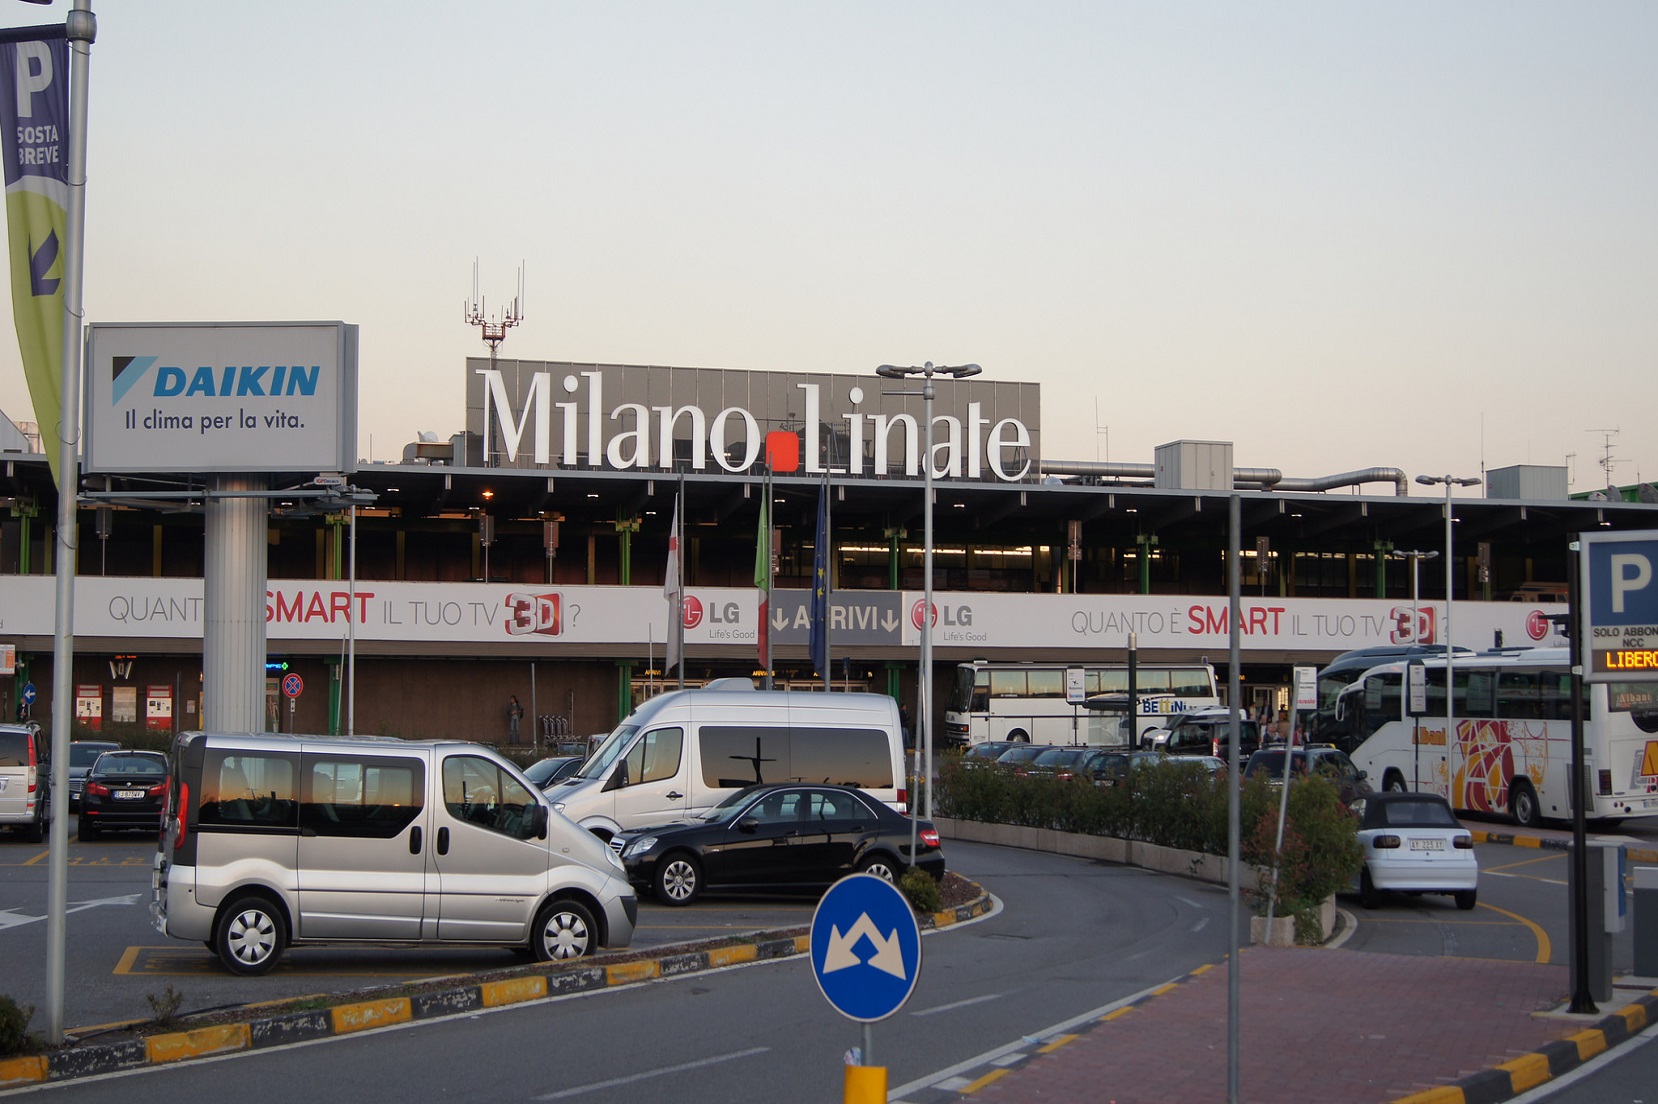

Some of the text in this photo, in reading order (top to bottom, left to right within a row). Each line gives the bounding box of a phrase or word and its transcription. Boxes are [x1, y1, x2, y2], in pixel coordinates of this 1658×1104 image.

[16, 40, 53, 117] P
[17, 125, 58, 144] SOSTA
[19, 145, 59, 165] BREVE
[153, 366, 320, 396] DAIKIN
[125, 408, 305, 434] Il clima per la vita.
[475, 369, 1031, 481] Milano Linate
[1611, 554, 1652, 613] P
[109, 596, 205, 624] QUANT
[384, 601, 403, 624] IL
[409, 601, 462, 625] TUO
[468, 602, 499, 626] TV
[504, 592, 560, 637] 3D
[709, 602, 740, 624] LG
[793, 605, 878, 631] ARIVI
[944, 605, 972, 626] LG
[1071, 611, 1164, 636] QUANTO
[1292, 614, 1308, 636] IL
[1312, 614, 1356, 637] TUO
[1360, 616, 1385, 637] TV
[709, 629, 755, 639] Life's Good
[944, 631, 987, 641] Life's Good
[1593, 627, 1620, 637] SOLO
[1622, 637, 1644, 647] NCC
